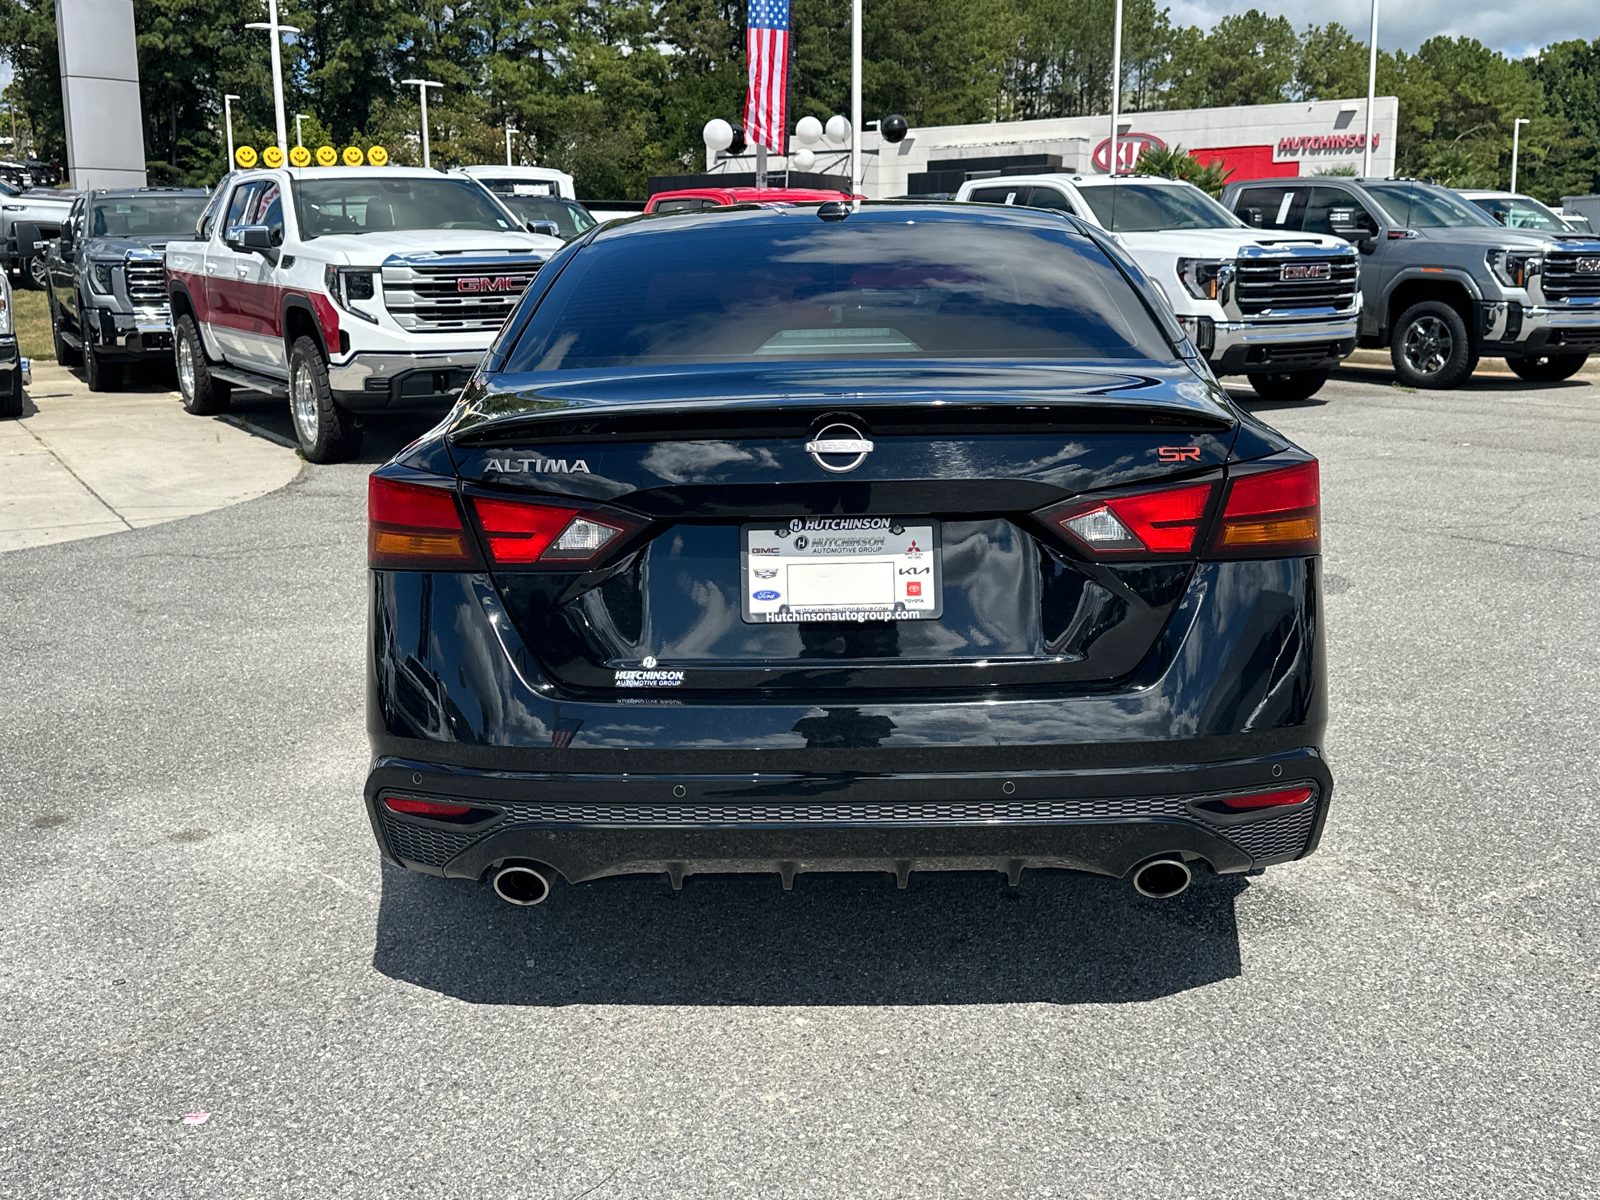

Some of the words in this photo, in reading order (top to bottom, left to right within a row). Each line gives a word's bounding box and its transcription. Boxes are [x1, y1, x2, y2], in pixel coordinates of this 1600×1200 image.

[1279, 133, 1380, 151] HUTCHINSON
[1284, 265, 1329, 278] GMC
[457, 276, 527, 292] GMC
[806, 440, 873, 452] NISSAN
[1158, 446, 1201, 462] SR
[483, 458, 591, 474] ALTIMA
[804, 517, 891, 531] HUTCHINSON
[765, 610, 920, 623] Hutchinsonautogroup.com
[615, 671, 685, 680] HUTCHINSON
